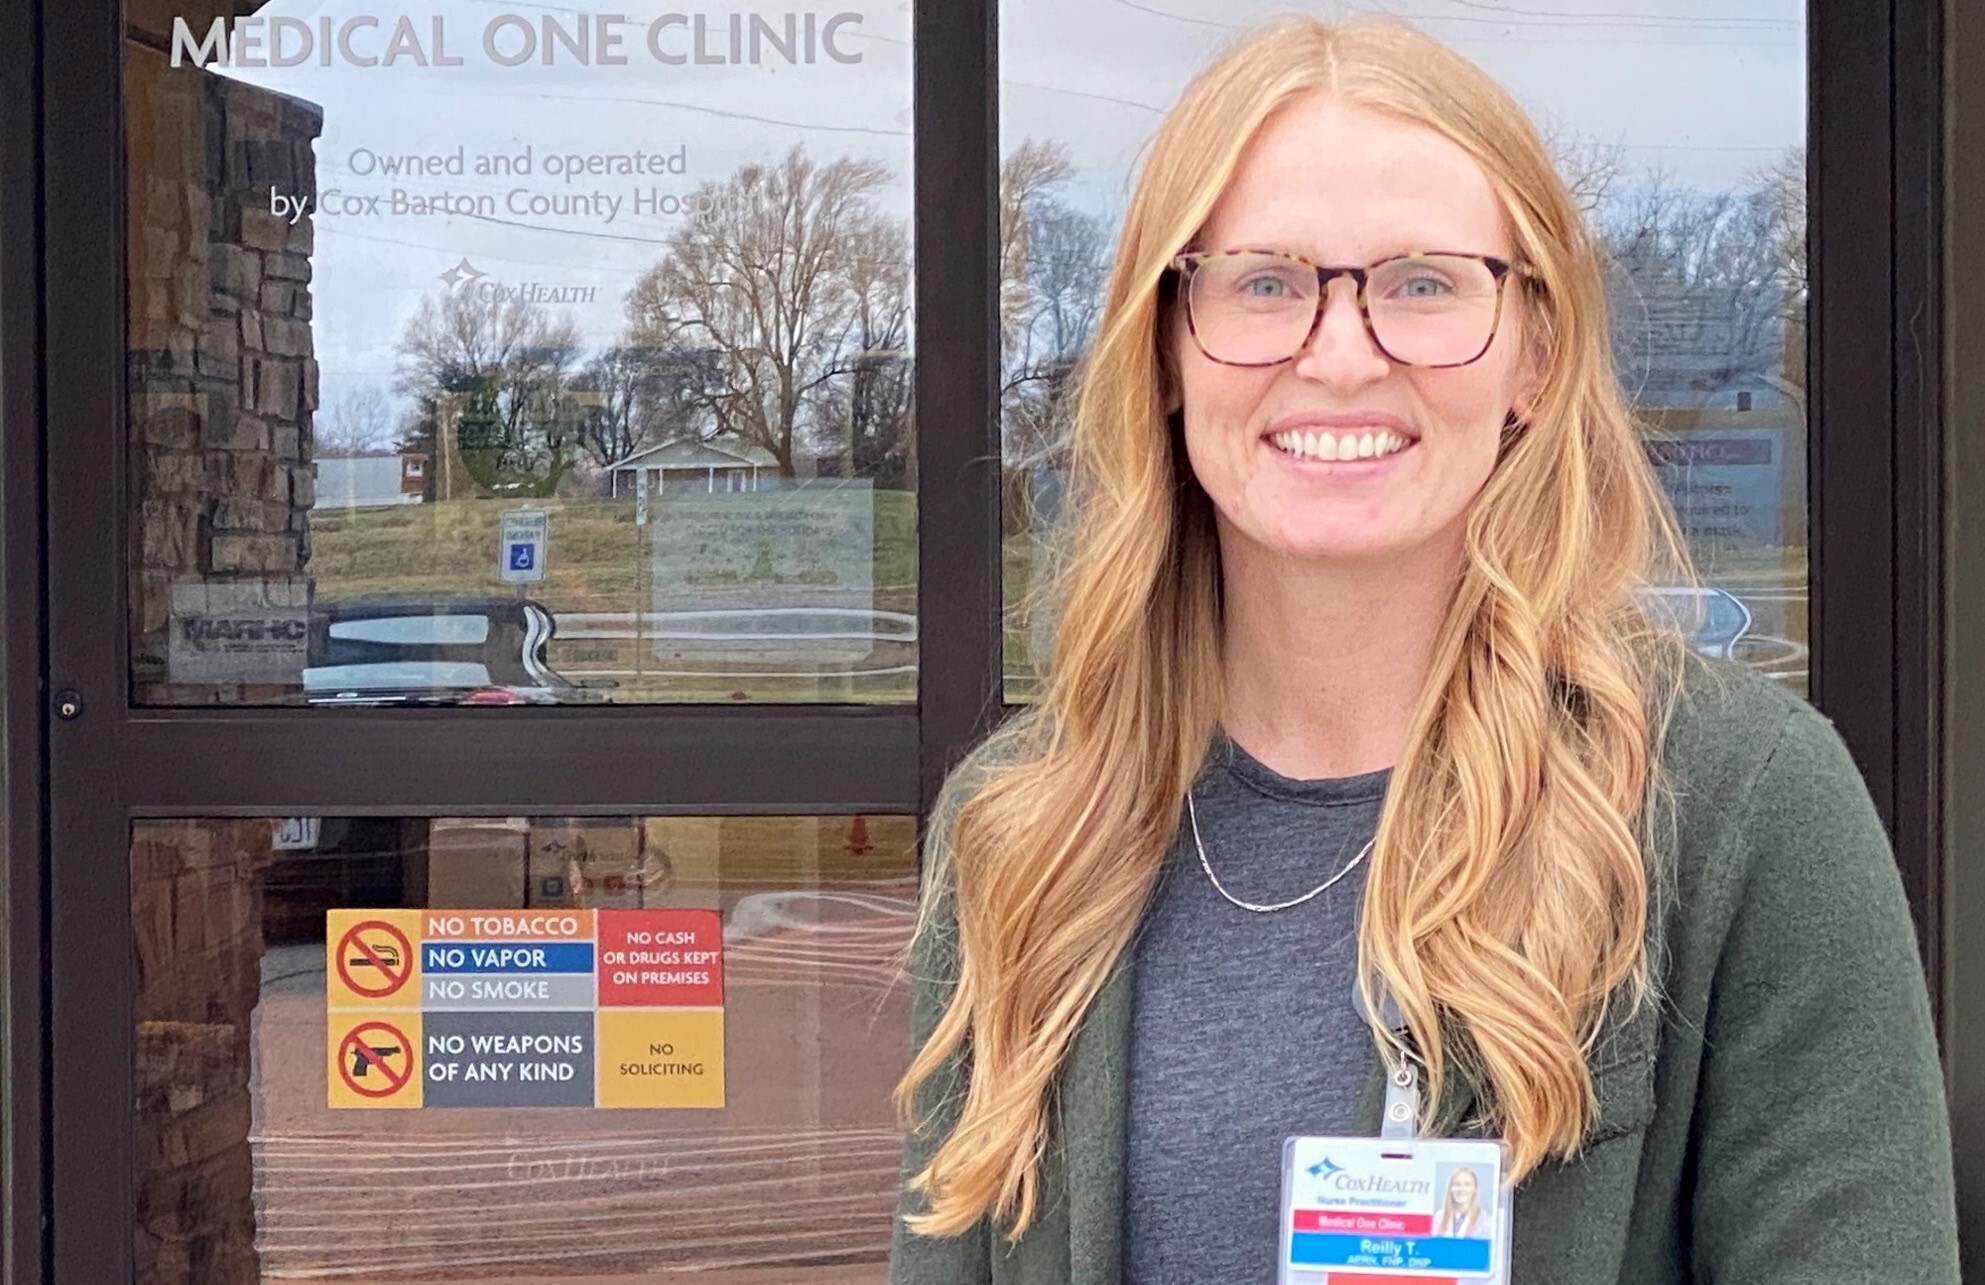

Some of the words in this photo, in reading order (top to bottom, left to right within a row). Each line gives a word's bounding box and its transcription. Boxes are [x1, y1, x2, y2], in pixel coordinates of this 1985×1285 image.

[170, 14, 464, 68] MEDICAL
[482, 13, 628, 67] ONE
[646, 12, 864, 66] CLINIC
[348, 145, 464, 176] Owned
[474, 145, 532, 175] and
[542, 144, 687, 184] operated
[270, 185, 308, 225] by
[319, 188, 380, 216] Cox
[391, 188, 496, 216] Barton
[505, 187, 623, 224] County
[428, 917, 465, 936] NO
[471, 916, 578, 936] TOBACCO
[626, 932, 652, 945] NO
[655, 932, 695, 945] CASH
[429, 949, 465, 968] NO
[471, 949, 547, 968] VAPOR
[603, 951, 626, 965] OR
[630, 951, 680, 965] DRUGS
[683, 951, 719, 965] KEPT
[612, 971, 638, 985] ON
[641, 971, 709, 985] PREMISES
[429, 981, 465, 999] NO
[471, 980, 550, 1000] SMOKE
[428, 1035, 465, 1055] NO
[470, 1034, 583, 1055] WEAPONS
[650, 1043, 674, 1056] NO
[428, 1062, 460, 1082] OF
[464, 1062, 514, 1082] ANY
[518, 1062, 574, 1082] KIND
[619, 1063, 704, 1076] SOLICITING
[1357, 1217, 1377, 1229] One
[1361, 1239, 1402, 1256] Reilly
[1406, 1241, 1420, 1256] T.
